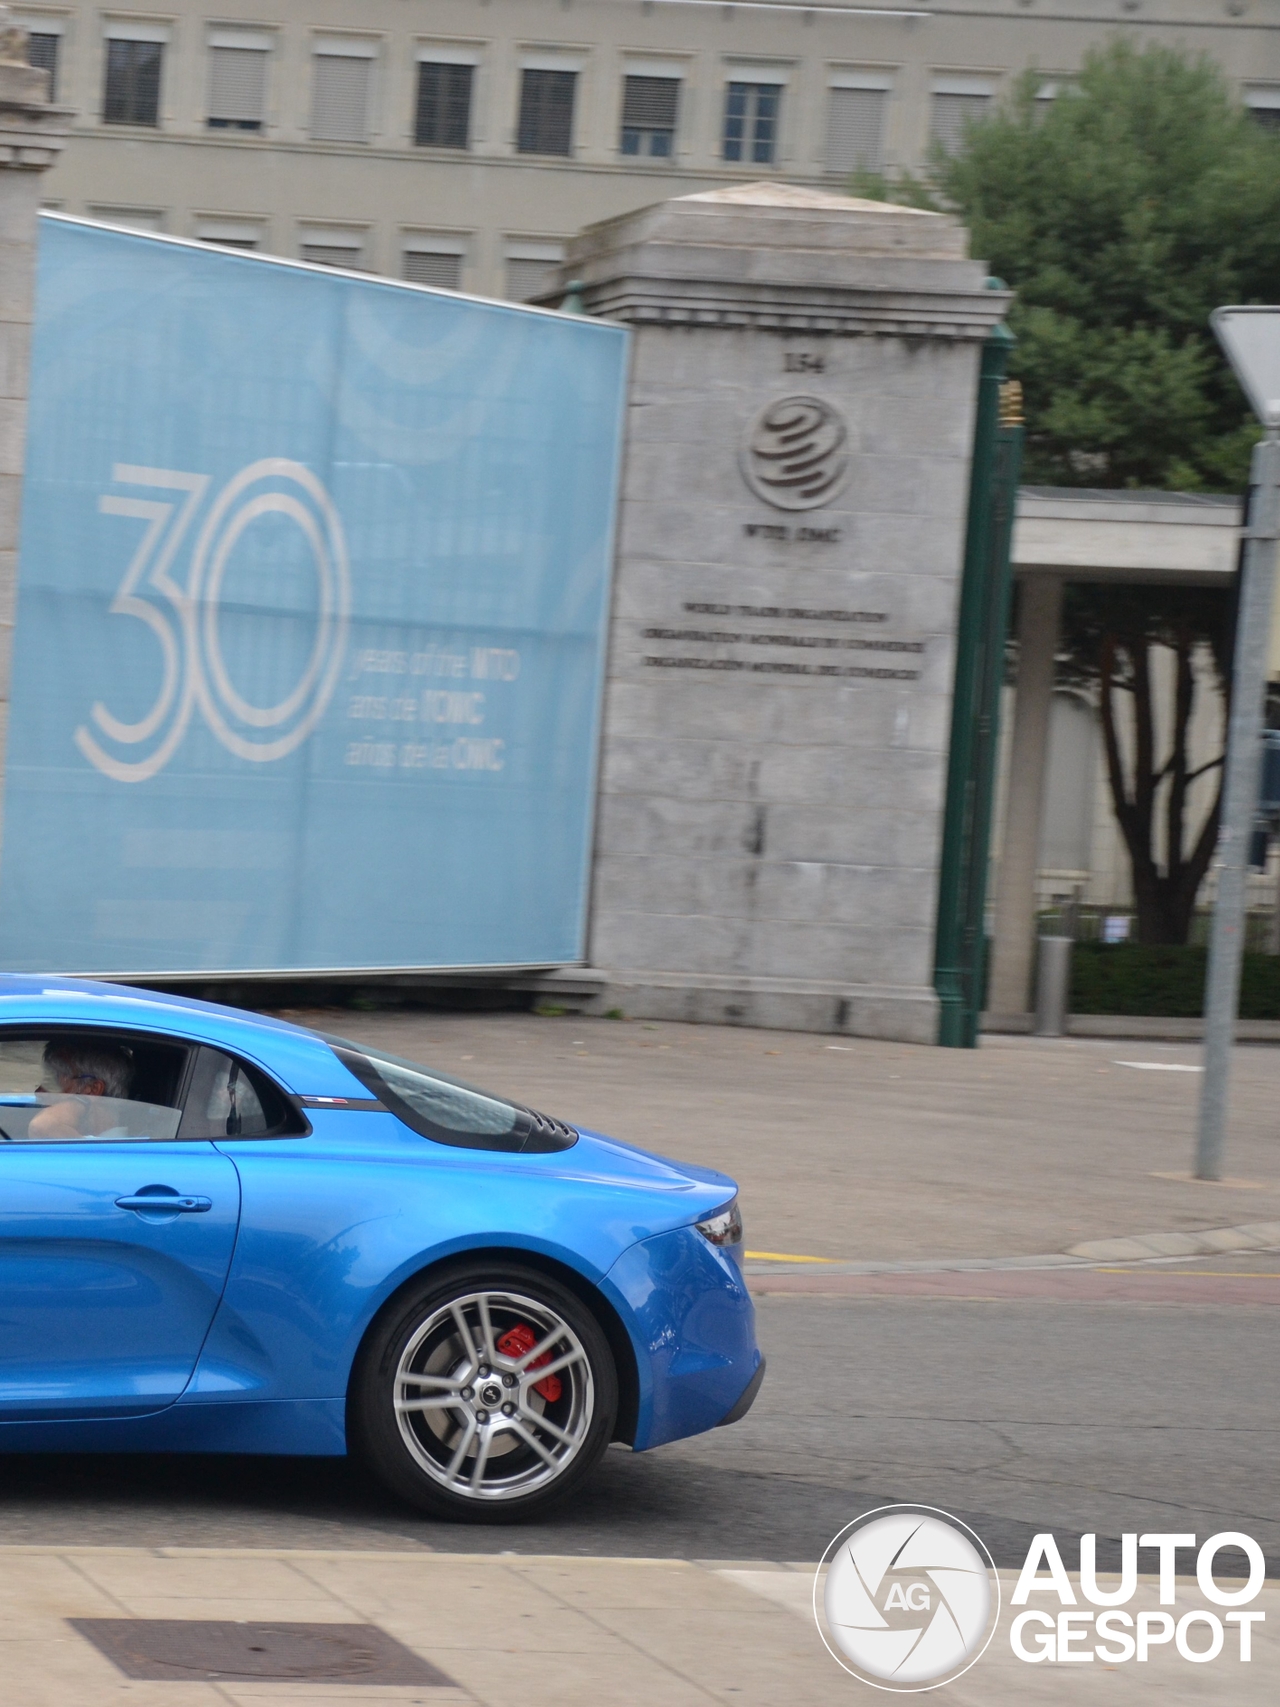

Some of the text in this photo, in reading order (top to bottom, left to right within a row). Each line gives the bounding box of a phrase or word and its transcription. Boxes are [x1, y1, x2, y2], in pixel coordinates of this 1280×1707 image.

[784, 353, 824, 373] 154
[73, 457, 351, 783] 30
[347, 650, 407, 681] years
[471, 647, 520, 682] WTO
[348, 695, 388, 720] ans
[452, 737, 506, 772] OMC
